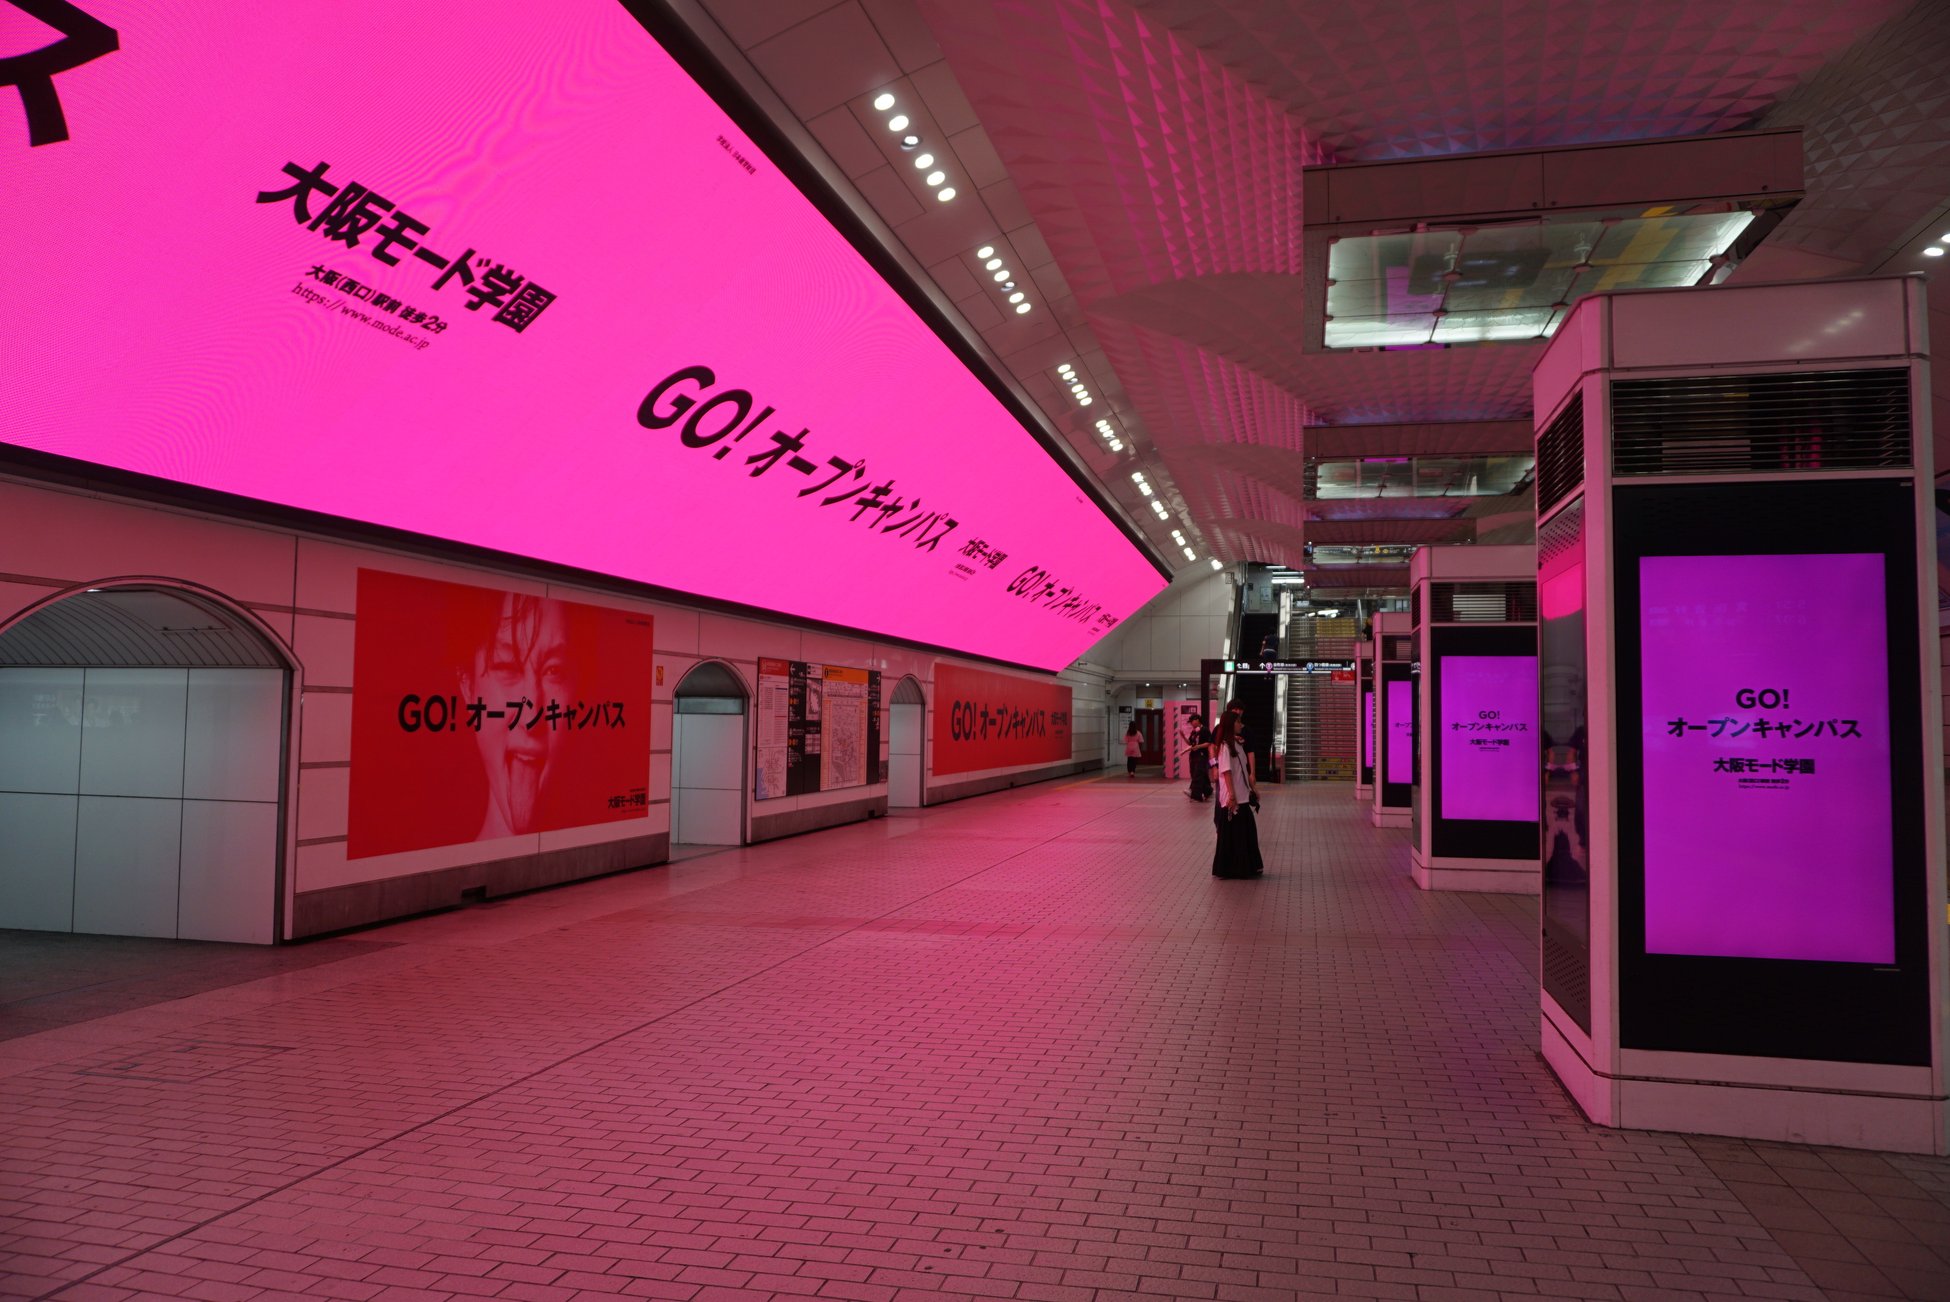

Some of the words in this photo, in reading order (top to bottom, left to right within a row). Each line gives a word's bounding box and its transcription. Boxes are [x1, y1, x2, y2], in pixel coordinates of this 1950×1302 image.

[256, 160, 557, 335] 大阪モード学園
[291, 281, 430, 350] https://www.mode.ac.jp
[398, 305, 448, 335] 徒歩2分
[637, 365, 775, 461] GO!
[745, 428, 959, 552] オープンキャンパス
[1006, 565, 1052, 598] GO!
[398, 693, 457, 733] GO!
[466, 696, 626, 732] オープンキャンパス
[1736, 688, 1790, 710] GO!
[951, 700, 977, 741] GO!
[979, 704, 1046, 740] オープンキャンパス
[1451, 722, 1529, 731] オープンキャンパス
[1478, 710, 1500, 720] GO!
[1667, 716, 1863, 740] オープンキャンパス
[1713, 757, 1815, 774] 大阪モード学園
